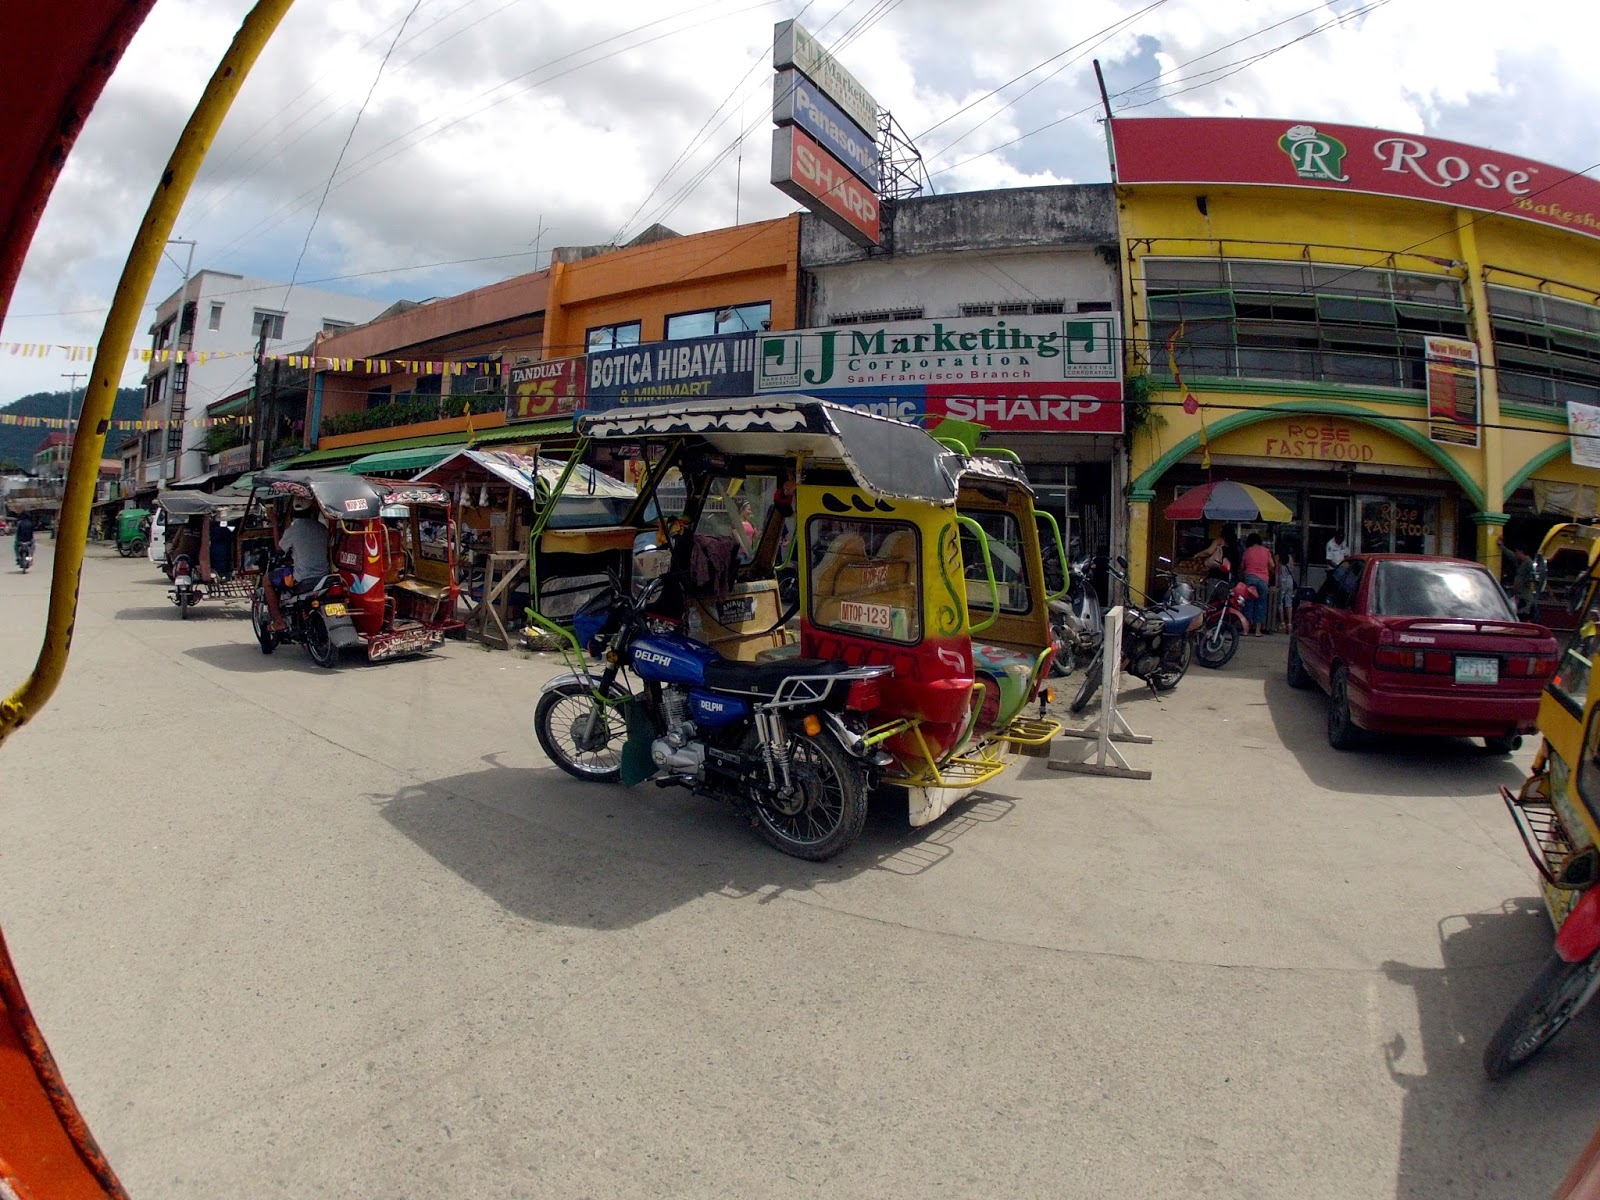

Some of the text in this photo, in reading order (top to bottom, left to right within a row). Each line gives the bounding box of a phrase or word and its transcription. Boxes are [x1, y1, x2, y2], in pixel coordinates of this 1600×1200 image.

[825, 59, 877, 123] Marketing
[796, 86, 876, 177] Panasonic
[1373, 137, 1530, 195] Rose
[796, 145, 876, 222] SHARP
[591, 351, 652, 388] BOTICA
[658, 342, 727, 381] HIBAYA
[804, 321, 1060, 385] J Marketing
[848, 353, 1030, 372] Corporation
[512, 362, 566, 383] TANDUAY
[848, 369, 1031, 383] San Francisco Branch
[619, 380, 711, 404] & MINIMART
[945, 395, 1100, 421] SHARP
[1288, 425, 1350, 442] ROSE
[841, 602, 889, 625] MTOP-123
[635, 649, 672, 667] DELPHI
[701, 700, 723, 712] DELPHI
